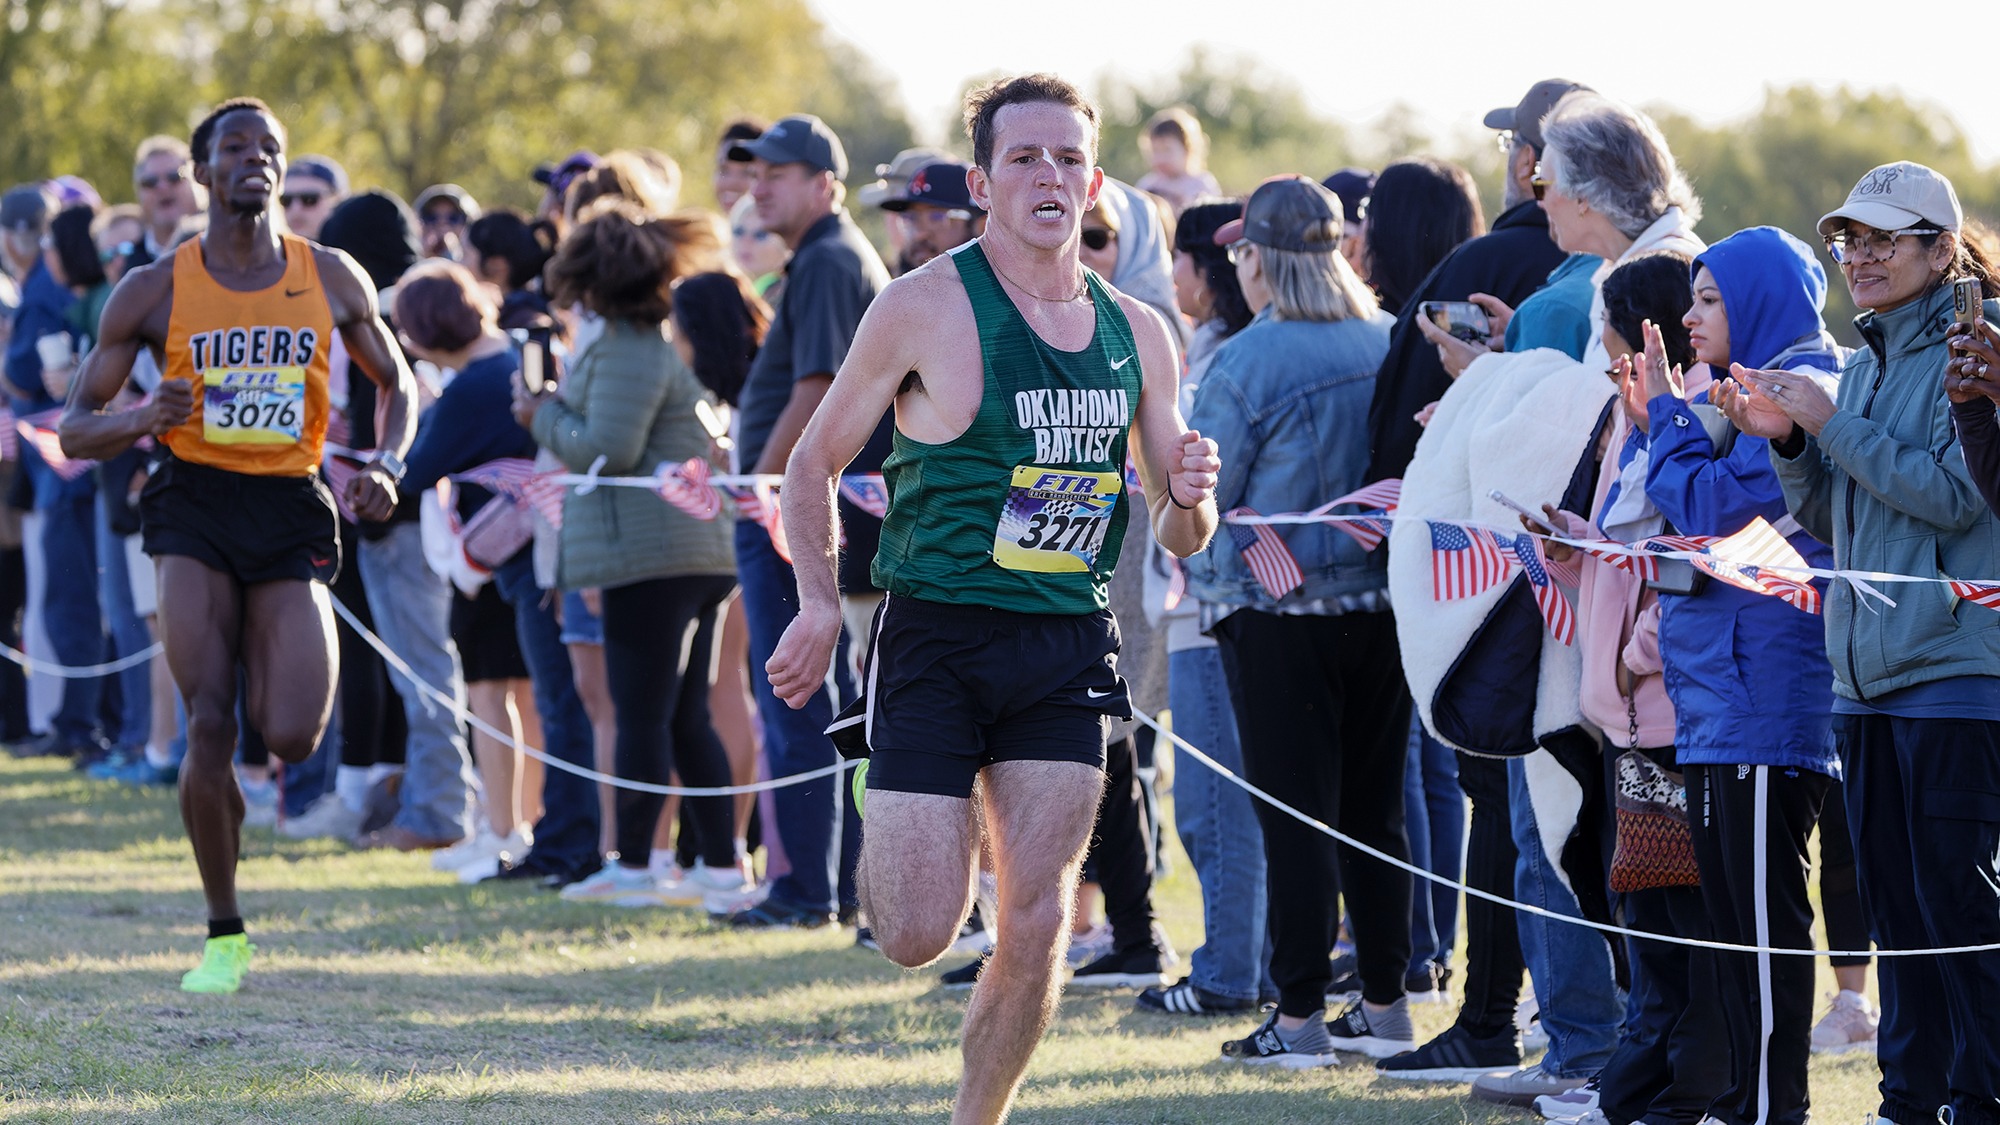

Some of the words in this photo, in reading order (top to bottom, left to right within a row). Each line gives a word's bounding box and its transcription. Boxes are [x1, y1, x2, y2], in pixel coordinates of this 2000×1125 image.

[189, 325, 318, 374] TIGERS
[217, 400, 296, 428] 3076
[1015, 388, 1129, 429] OKLAHOMA
[1032, 427, 1120, 464] BAPTIST
[1031, 472, 1100, 494] FTR
[1017, 513, 1102, 552] 3271
